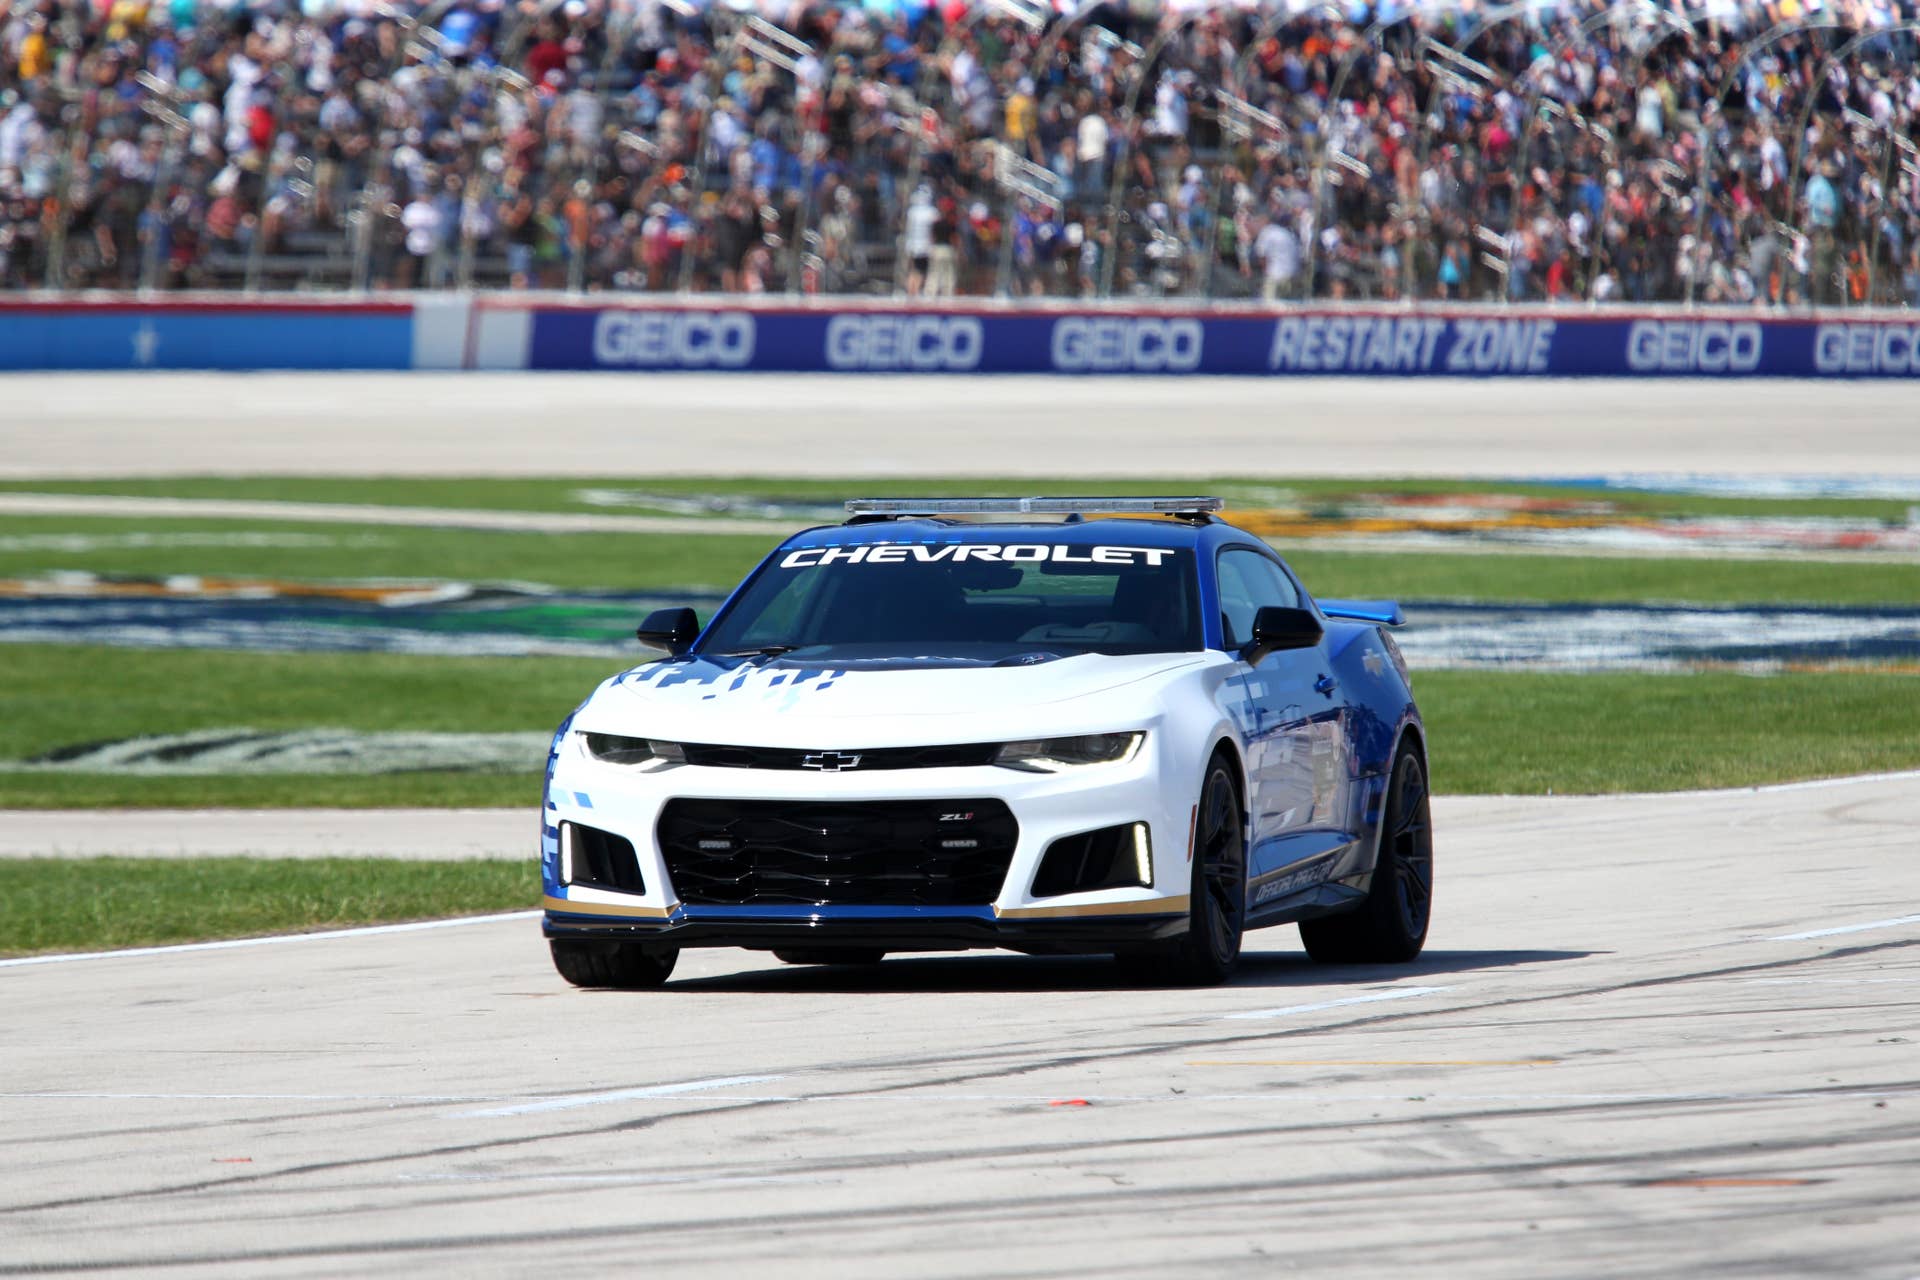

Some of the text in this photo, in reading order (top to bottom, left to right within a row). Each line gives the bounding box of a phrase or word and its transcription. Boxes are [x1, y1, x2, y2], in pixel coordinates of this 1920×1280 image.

[593, 311, 756, 366] GEICO
[826, 314, 983, 368] GEICO
[1050, 316, 1203, 369] GEICO
[1270, 316, 1556, 371] RESTART ZONE
[1626, 319, 1763, 371] GEICO
[1814, 323, 1920, 373] GEIC
[780, 544, 1174, 568] CHEVROLET
